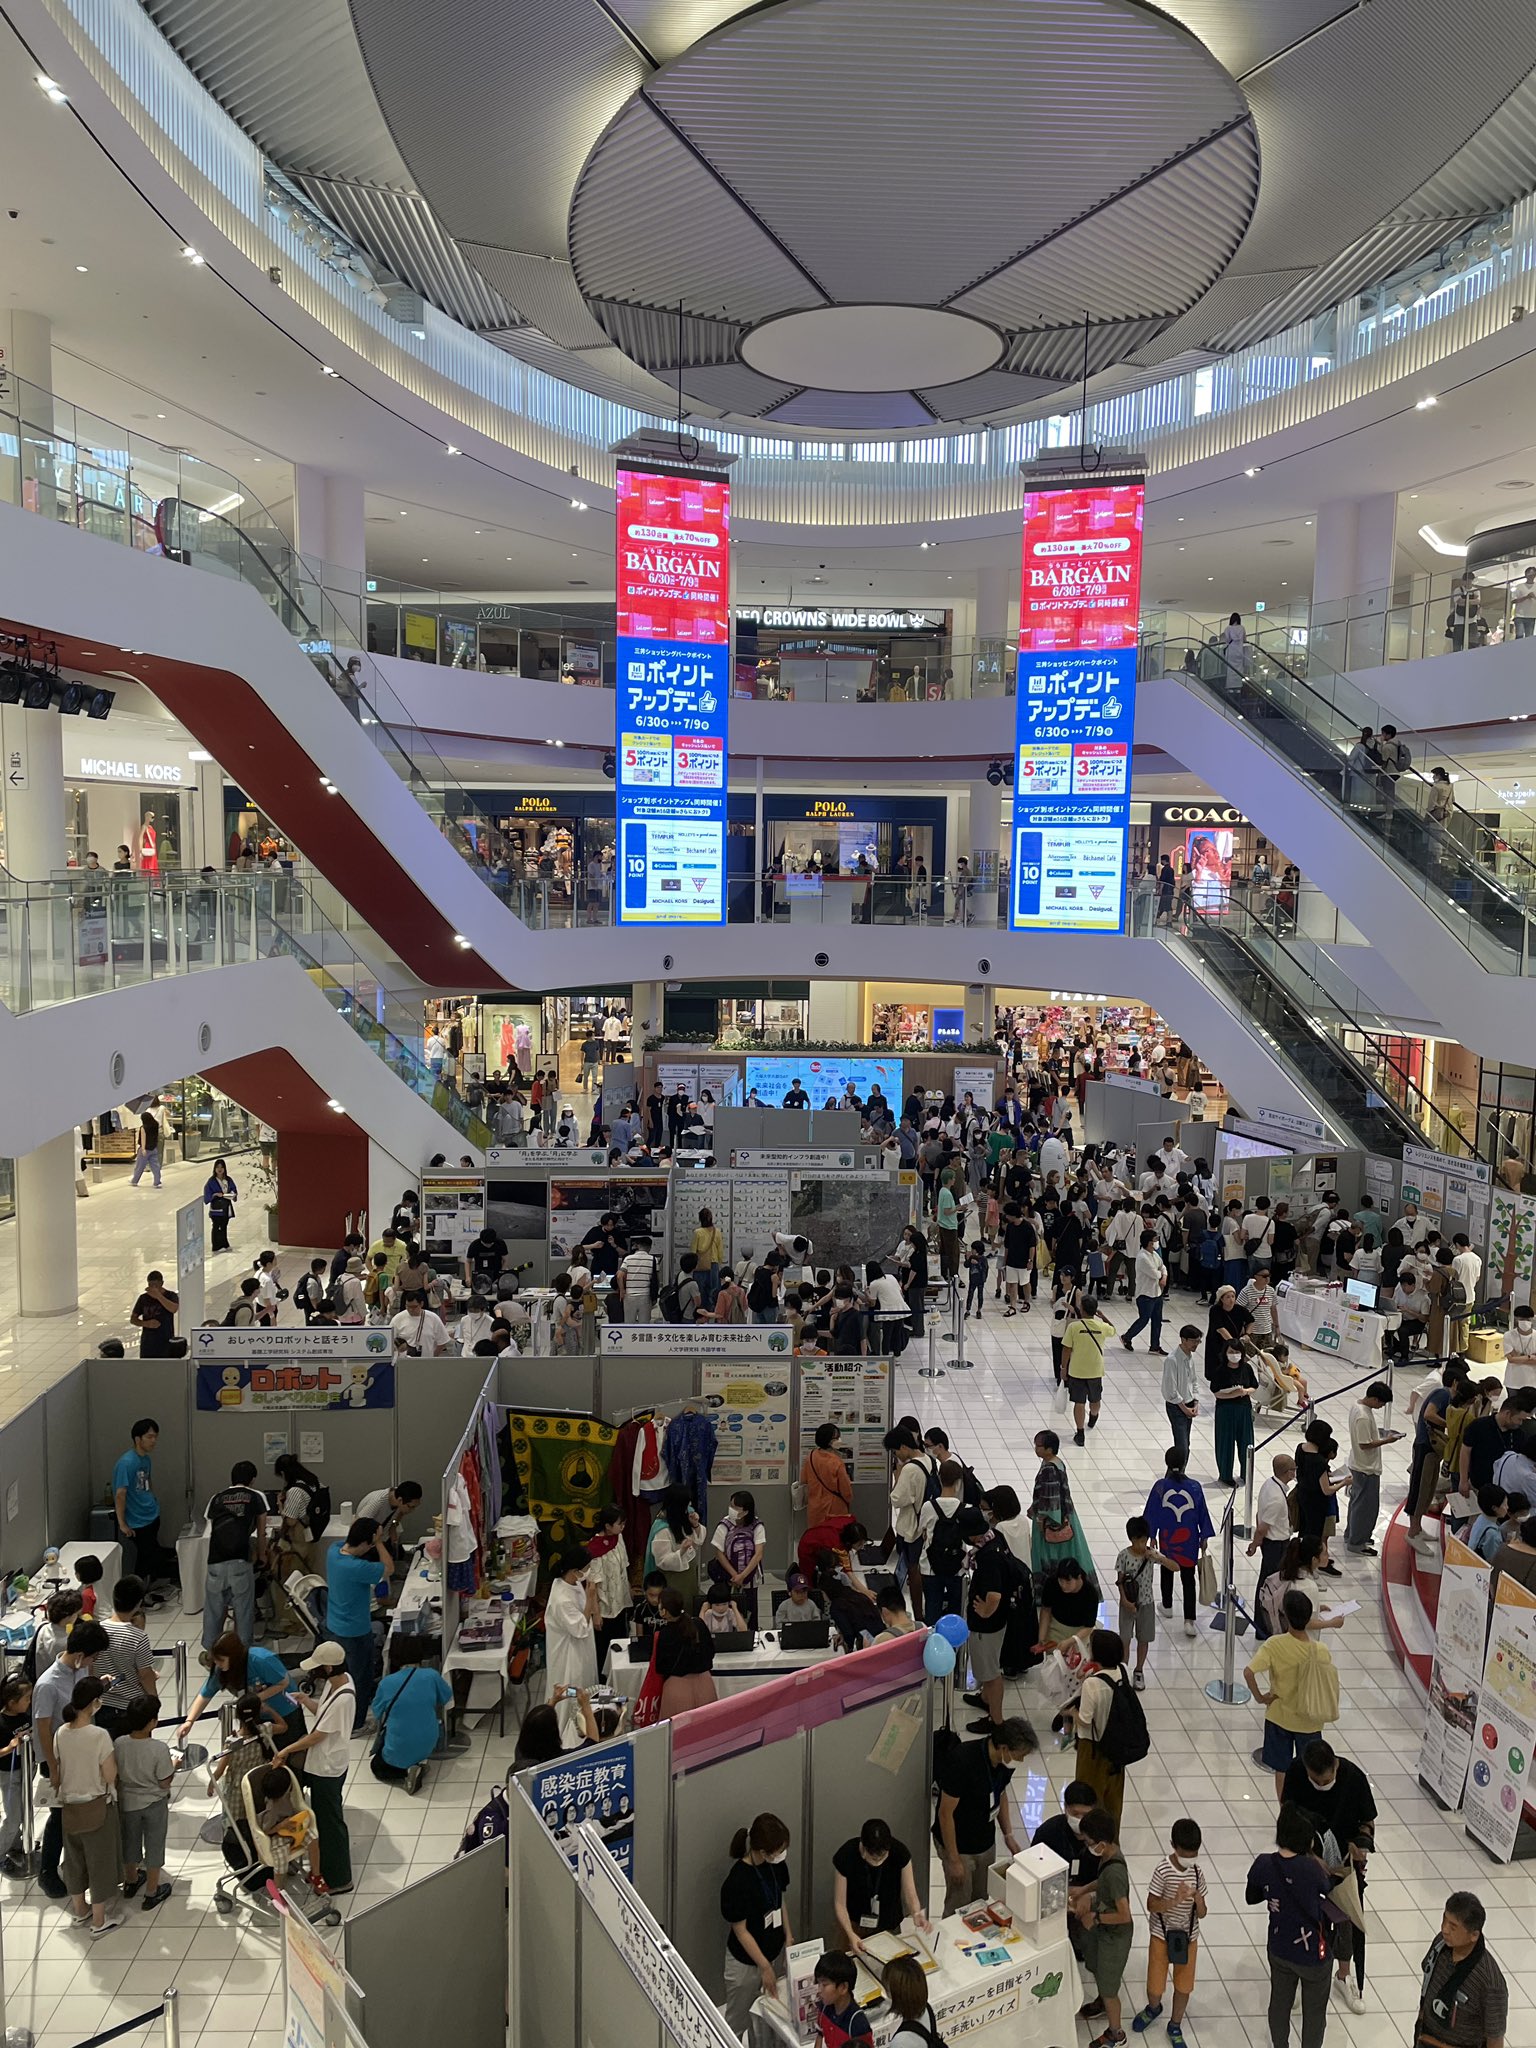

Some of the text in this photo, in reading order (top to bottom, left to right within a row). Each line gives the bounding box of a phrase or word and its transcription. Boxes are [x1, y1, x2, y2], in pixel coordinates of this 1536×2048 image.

[625, 552, 720, 578] BARGAIN
[1030, 564, 1132, 587] BARGAIN
[477, 607, 510, 620] AZUL
[764, 610, 827, 627] CROWNS
[832, 613, 866, 628] WIDE
[868, 614, 908, 628] BOWL
[646, 660, 714, 686] ポイント
[1047, 669, 1120, 695] ポイント
[626, 750, 636, 766] 5
[637, 756, 668, 767] ポイント
[678, 752, 688, 768] 3
[689, 758, 719, 769] ポイント
[80, 758, 182, 780] MICHAEL KORS
[1023, 761, 1034, 776] 5
[1034, 766, 1066, 776] ポイント
[1077, 760, 1088, 776] 3
[1089, 766, 1122, 776] ポイント
[522, 798, 550, 807] POLO
[814, 802, 846, 812] POLO
[628, 858, 644, 872] 10
[1022, 866, 1040, 880] 10
[227, 1336, 354, 1344] おしゃべりロボットと話そう!
[631, 1333, 762, 1342] 多言語・多文化を楽しみ育む未来社会へ!
[824, 1362, 863, 1372] 活動紹介
[251, 1366, 342, 1392] ロボット
[541, 1763, 627, 1799] 感染症教育
